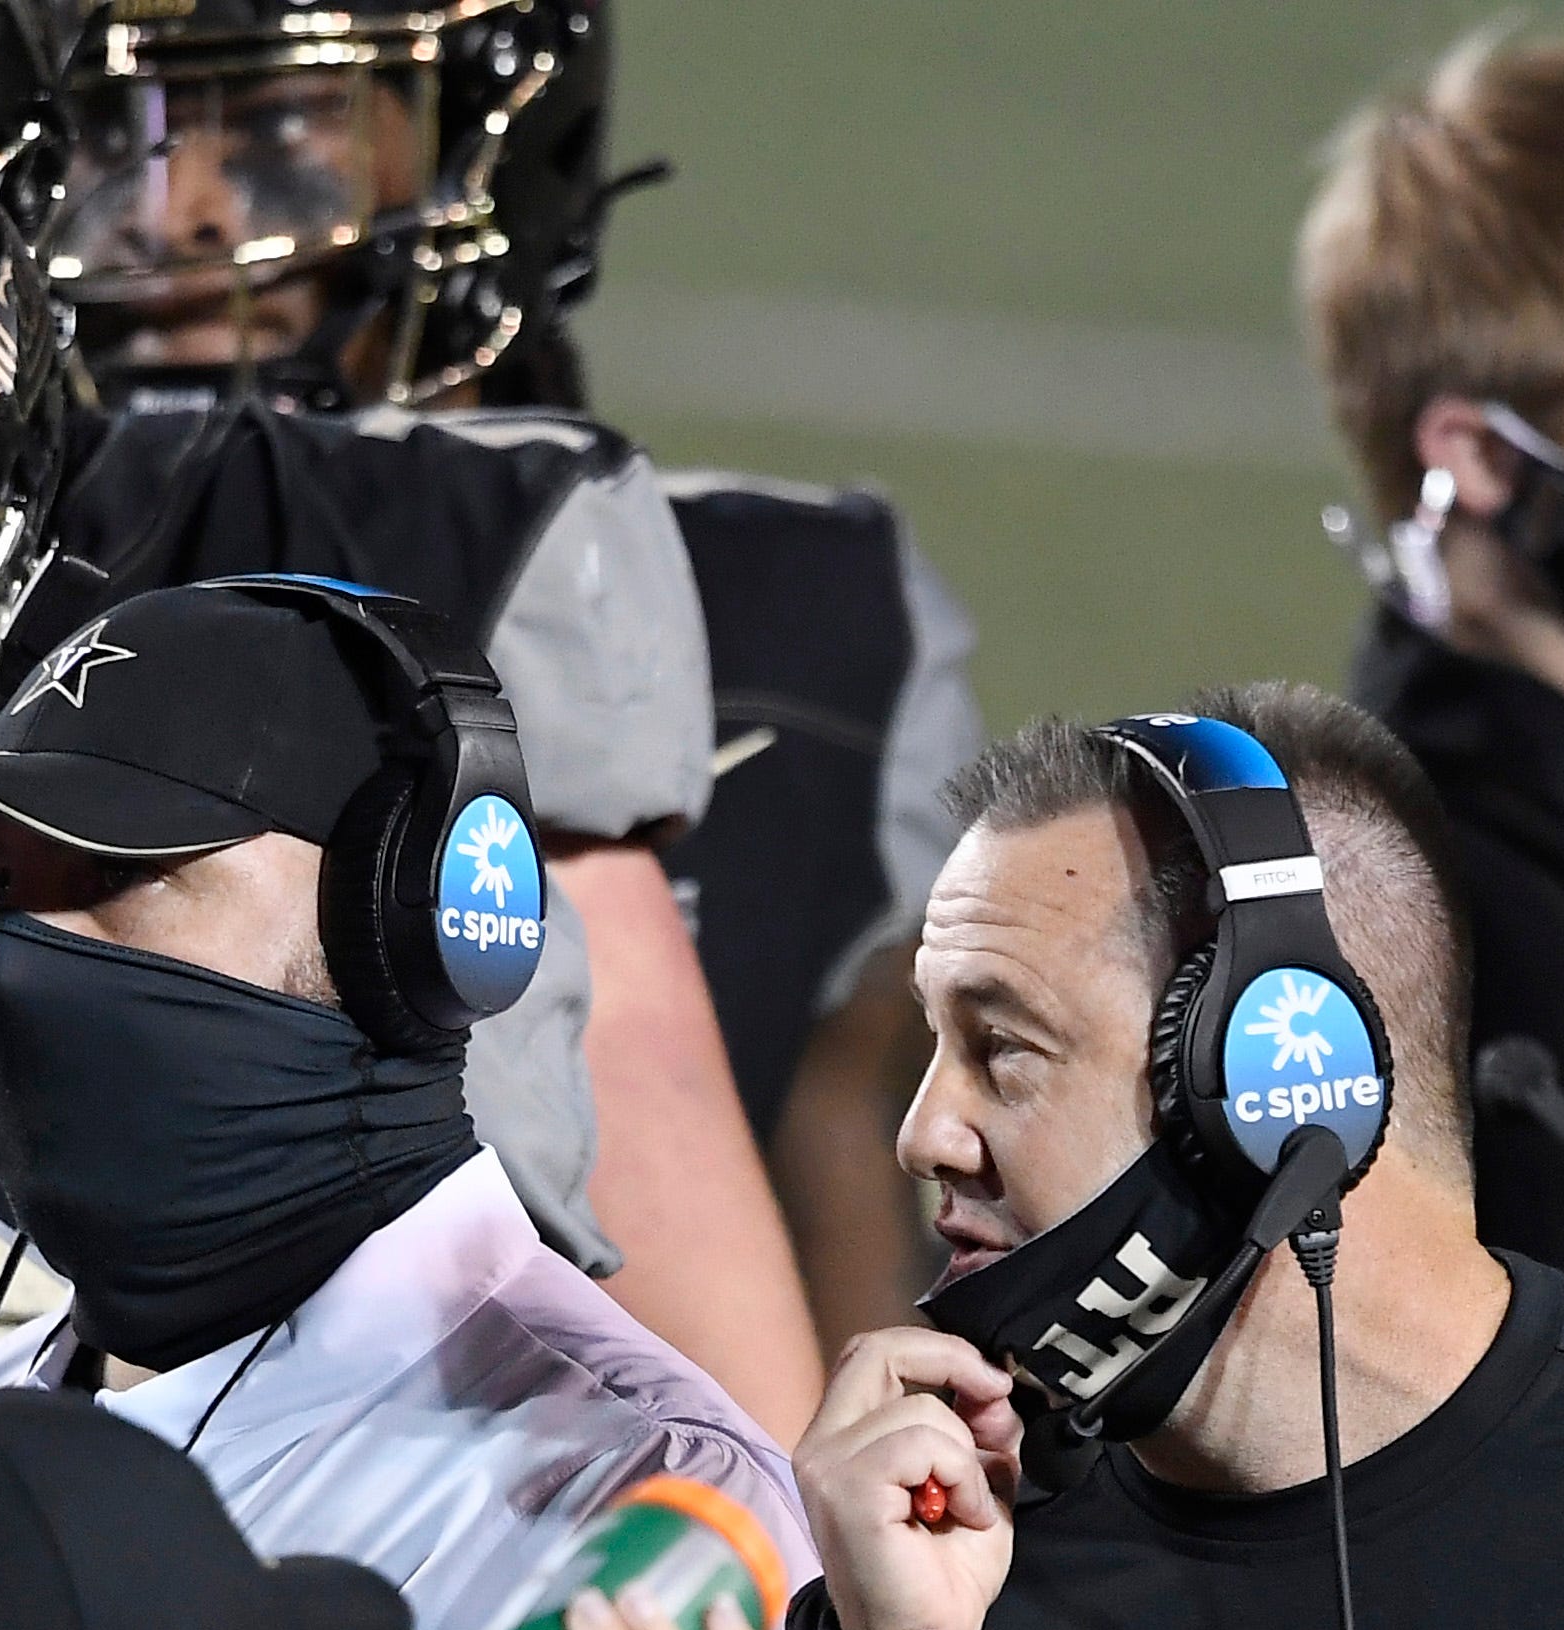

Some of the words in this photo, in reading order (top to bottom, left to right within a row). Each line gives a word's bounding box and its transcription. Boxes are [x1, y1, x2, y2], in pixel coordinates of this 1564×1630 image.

[1253, 870, 1297, 887] FITCH
[463, 909, 540, 952] spire
[1268, 1075, 1381, 1125] spire
